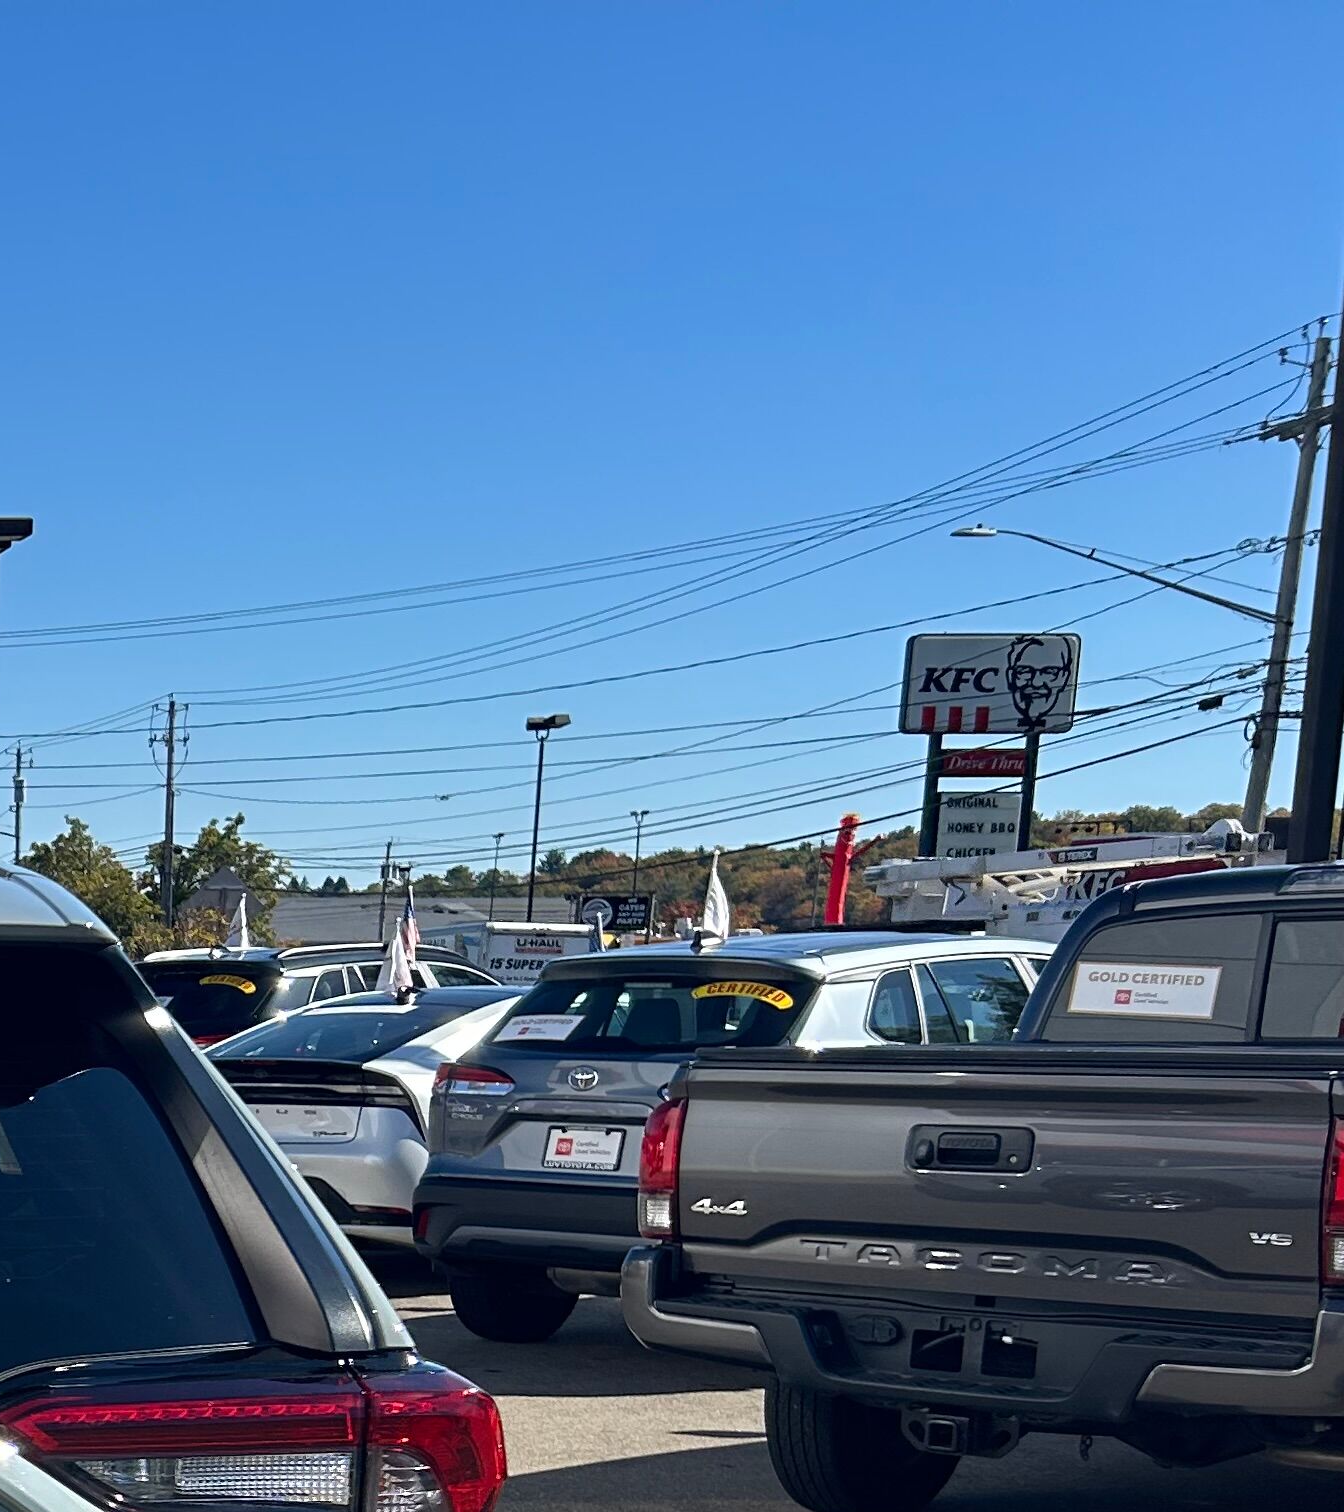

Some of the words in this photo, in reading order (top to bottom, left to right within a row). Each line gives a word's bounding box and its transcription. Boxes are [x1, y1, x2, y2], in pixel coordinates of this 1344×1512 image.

[918, 667, 1000, 693] KFC
[946, 755, 986, 770] Drive
[991, 755, 1025, 770] Thru
[946, 797, 999, 808] ORIGINAL
[947, 822, 985, 833] HONEY
[990, 822, 1016, 833] BBQ
[1088, 971, 1129, 983] GOLD
[1132, 973, 1205, 986] CERTIFIED
[706, 983, 787, 1003] CERTIFIED
[690, 1197, 749, 1215] 4x4
[1248, 1231, 1294, 1247] V6
[799, 1238, 1167, 1284] TACOMA
